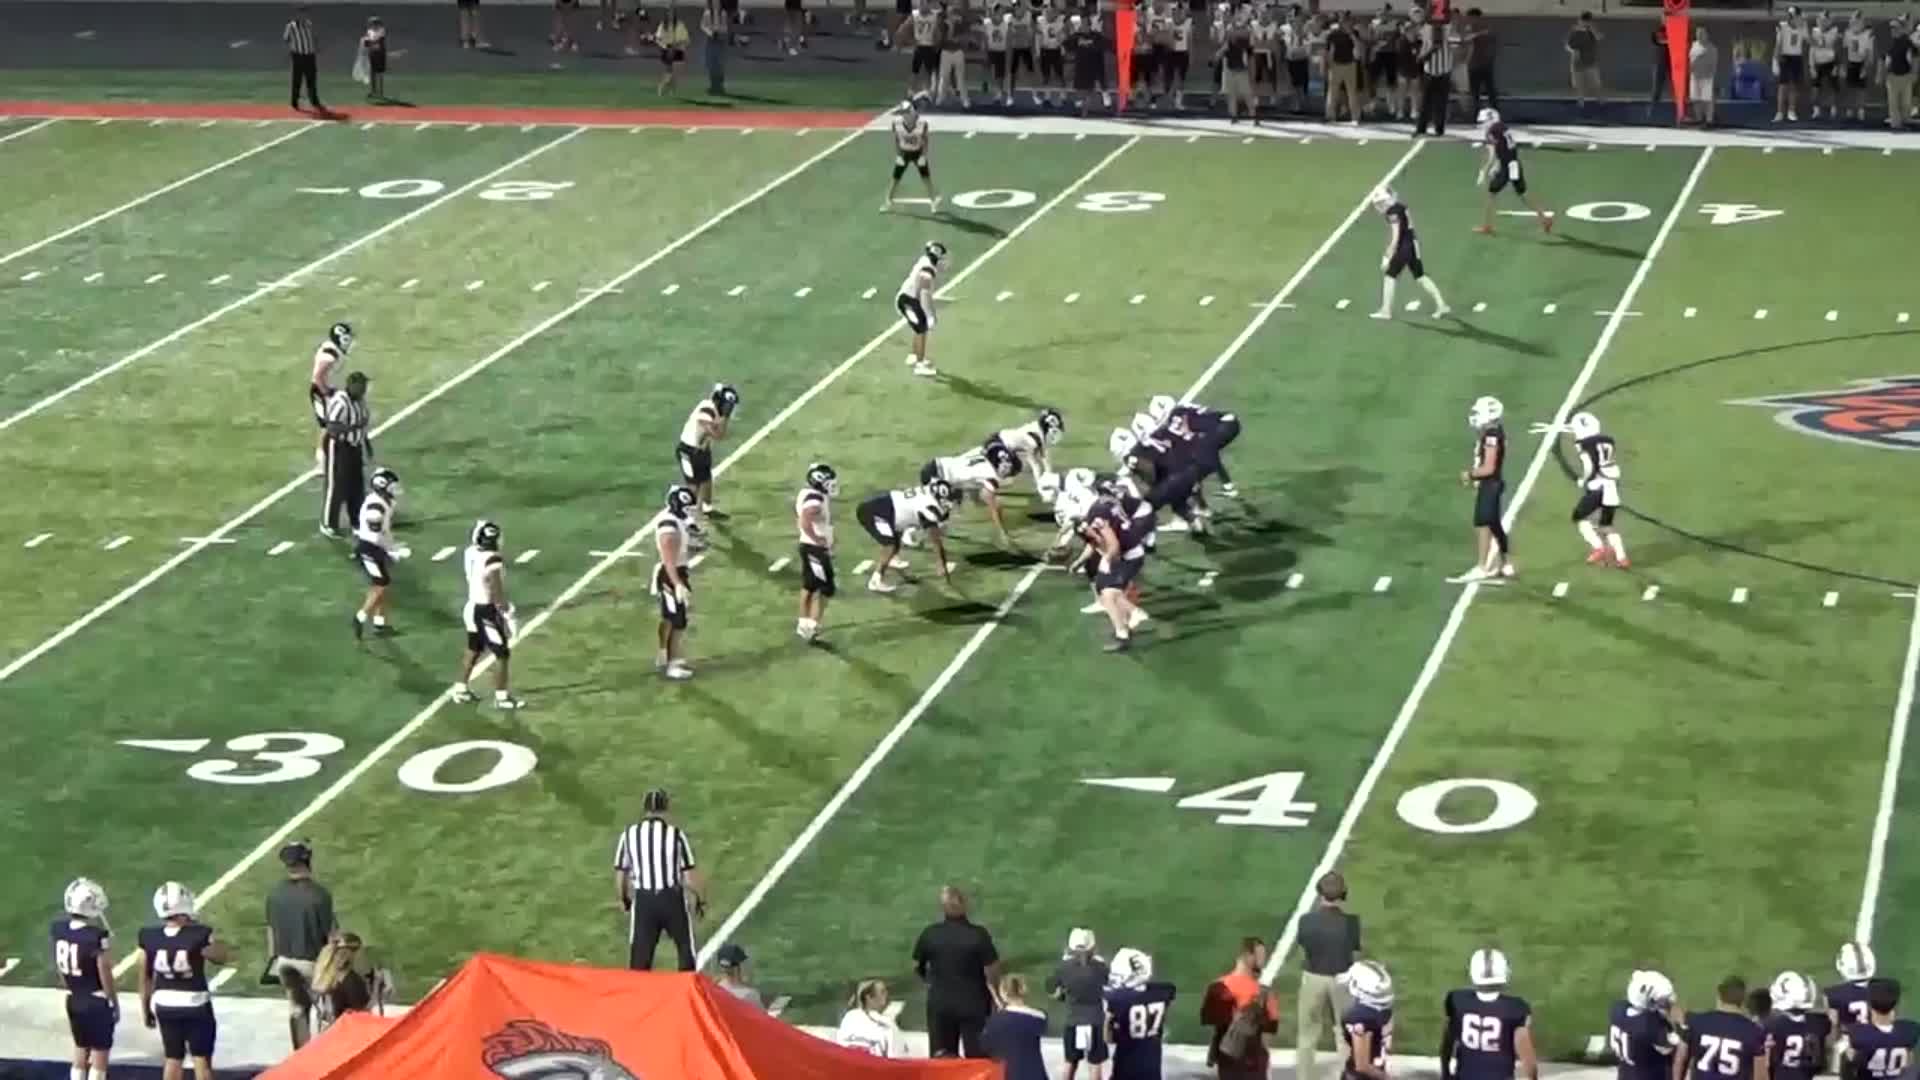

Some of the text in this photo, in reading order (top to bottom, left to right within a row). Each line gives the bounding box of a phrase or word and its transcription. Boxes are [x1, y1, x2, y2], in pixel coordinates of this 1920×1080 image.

[56, 939, 83, 976] 81
[154, 950, 194, 979] 44
[1129, 1001, 1166, 1038] 87
[1462, 1013, 1501, 1052] 62
[1697, 1034, 1742, 1075] 75
[1867, 1047, 1908, 1077] 40
